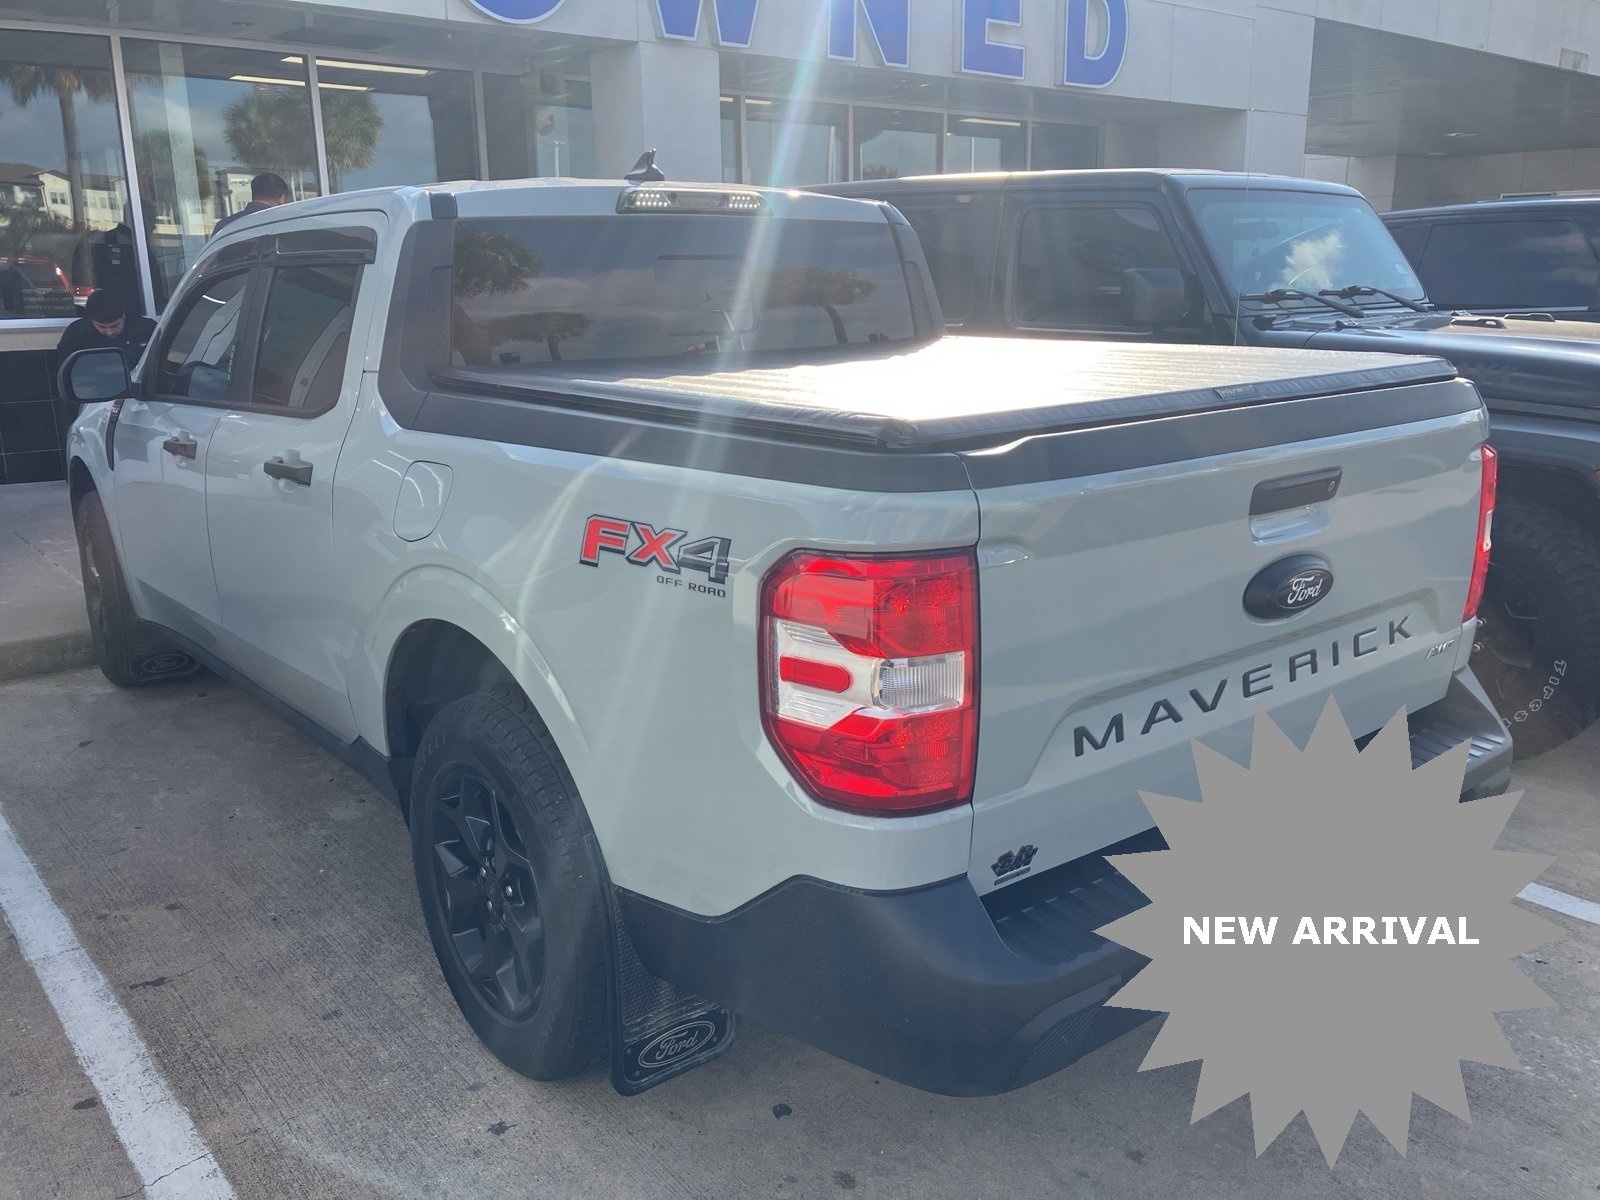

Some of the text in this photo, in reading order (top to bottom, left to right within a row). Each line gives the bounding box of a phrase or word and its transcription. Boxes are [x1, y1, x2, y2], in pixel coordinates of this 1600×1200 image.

[579, 514, 732, 585] FX4
[656, 575, 726, 598] OFF ROAD
[1287, 575, 1323, 605] Ford
[1073, 613, 1414, 758] MAVERICK
[655, 1030, 699, 1060] Ford
